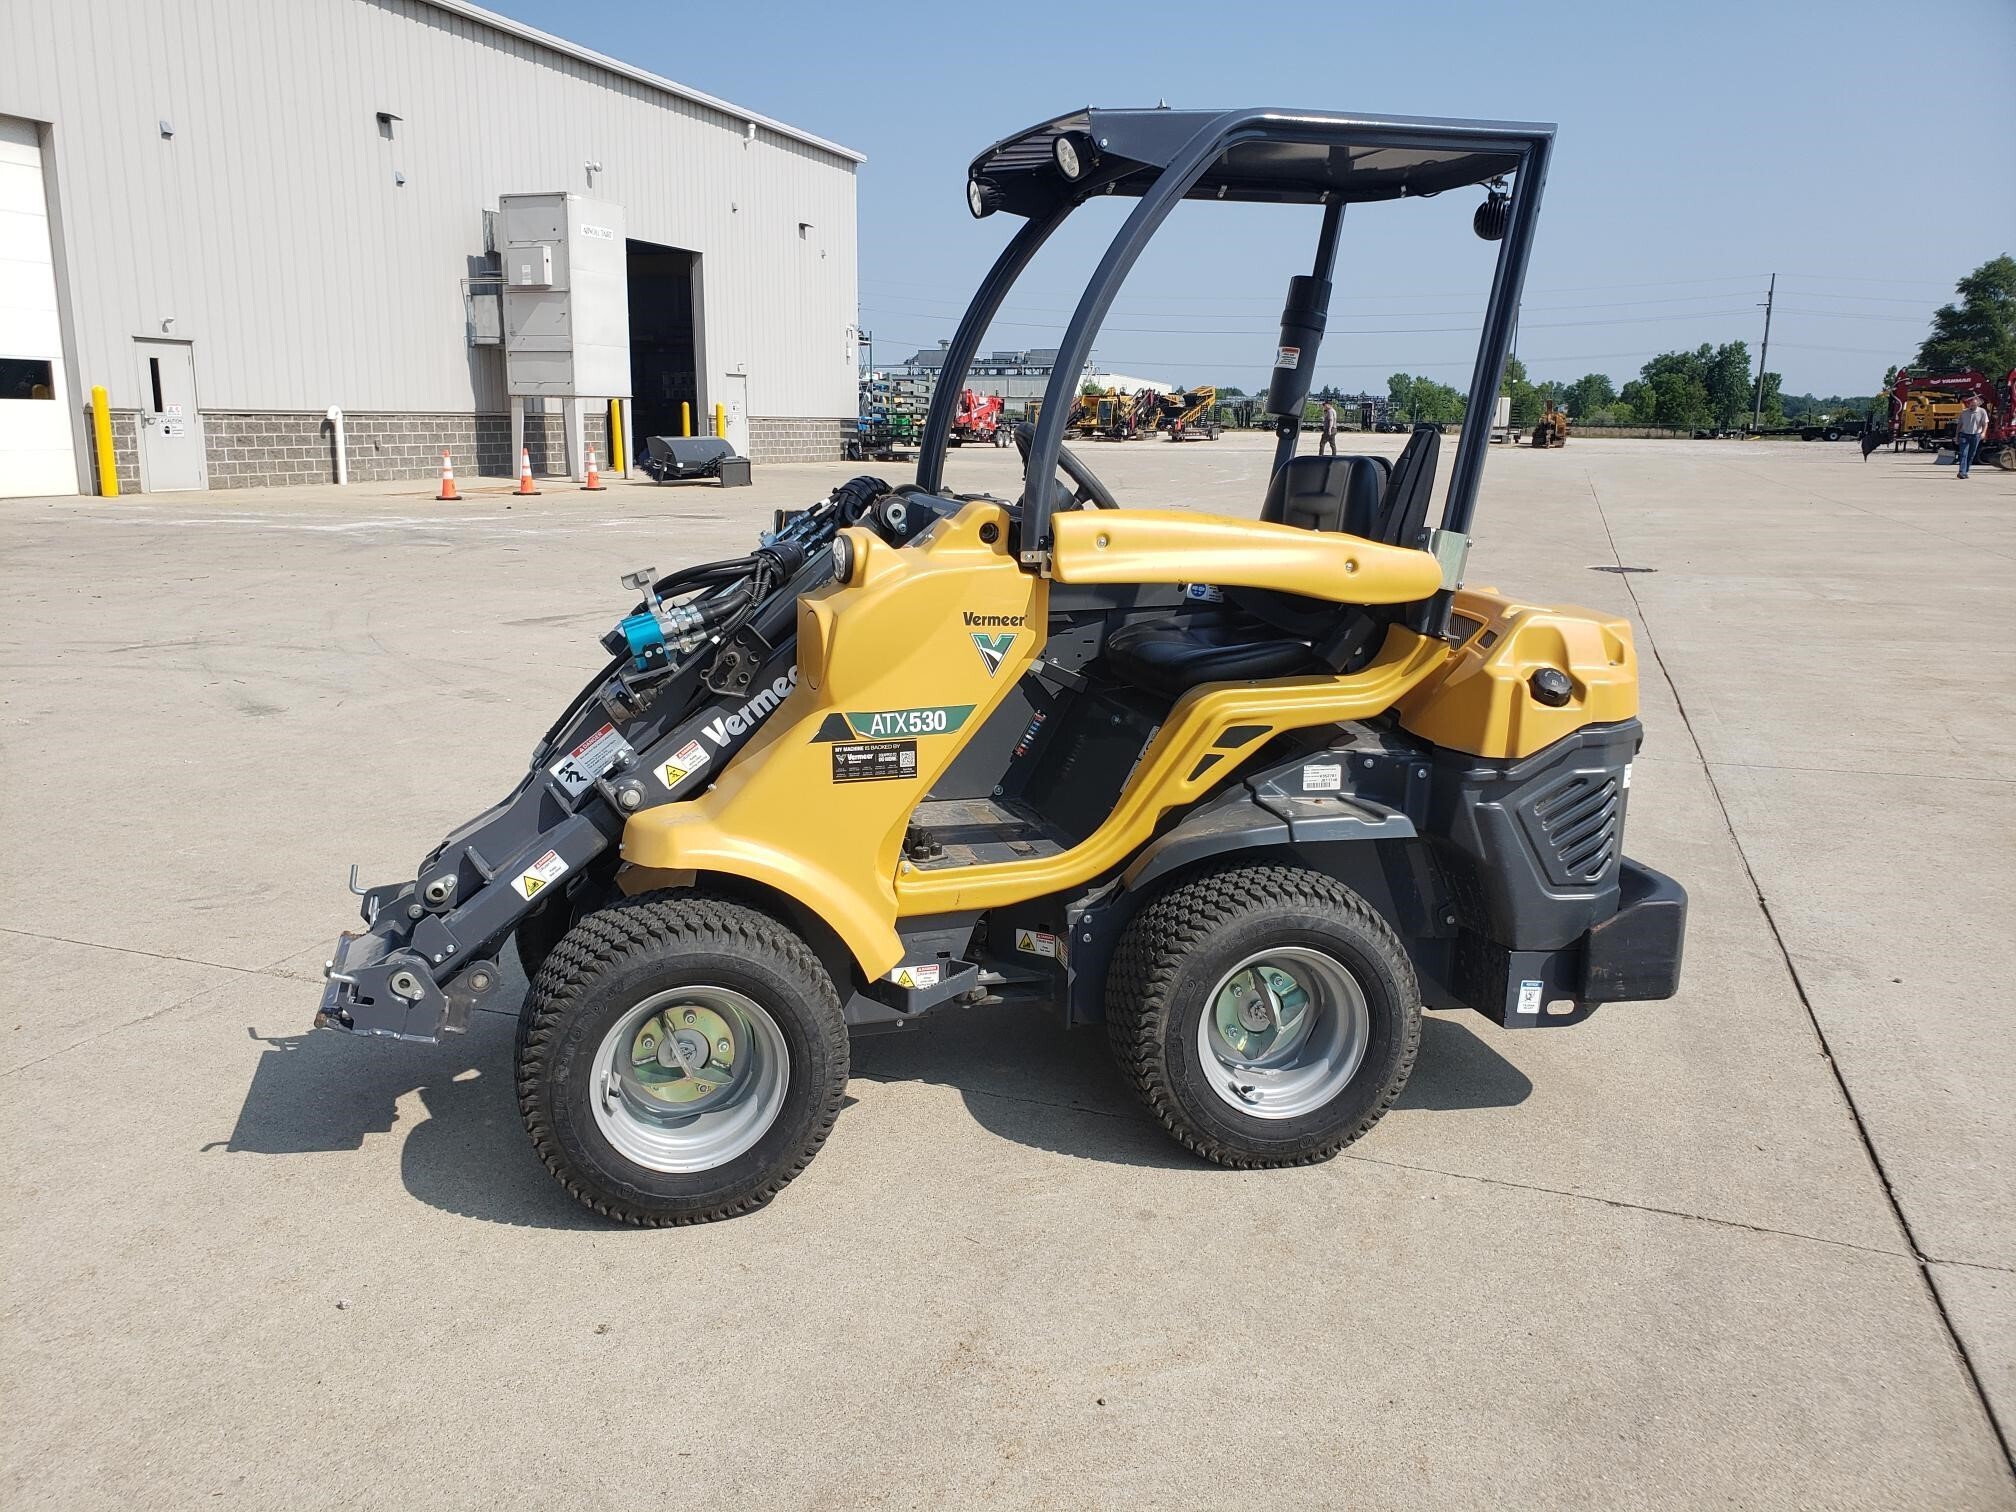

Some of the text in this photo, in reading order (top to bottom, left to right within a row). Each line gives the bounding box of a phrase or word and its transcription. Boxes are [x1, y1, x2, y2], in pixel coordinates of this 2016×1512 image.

[963, 611, 1025, 627] Vermeer
[701, 664, 798, 748] Verme
[870, 710, 947, 735] ATX530
[847, 753, 874, 761] Vermeer
